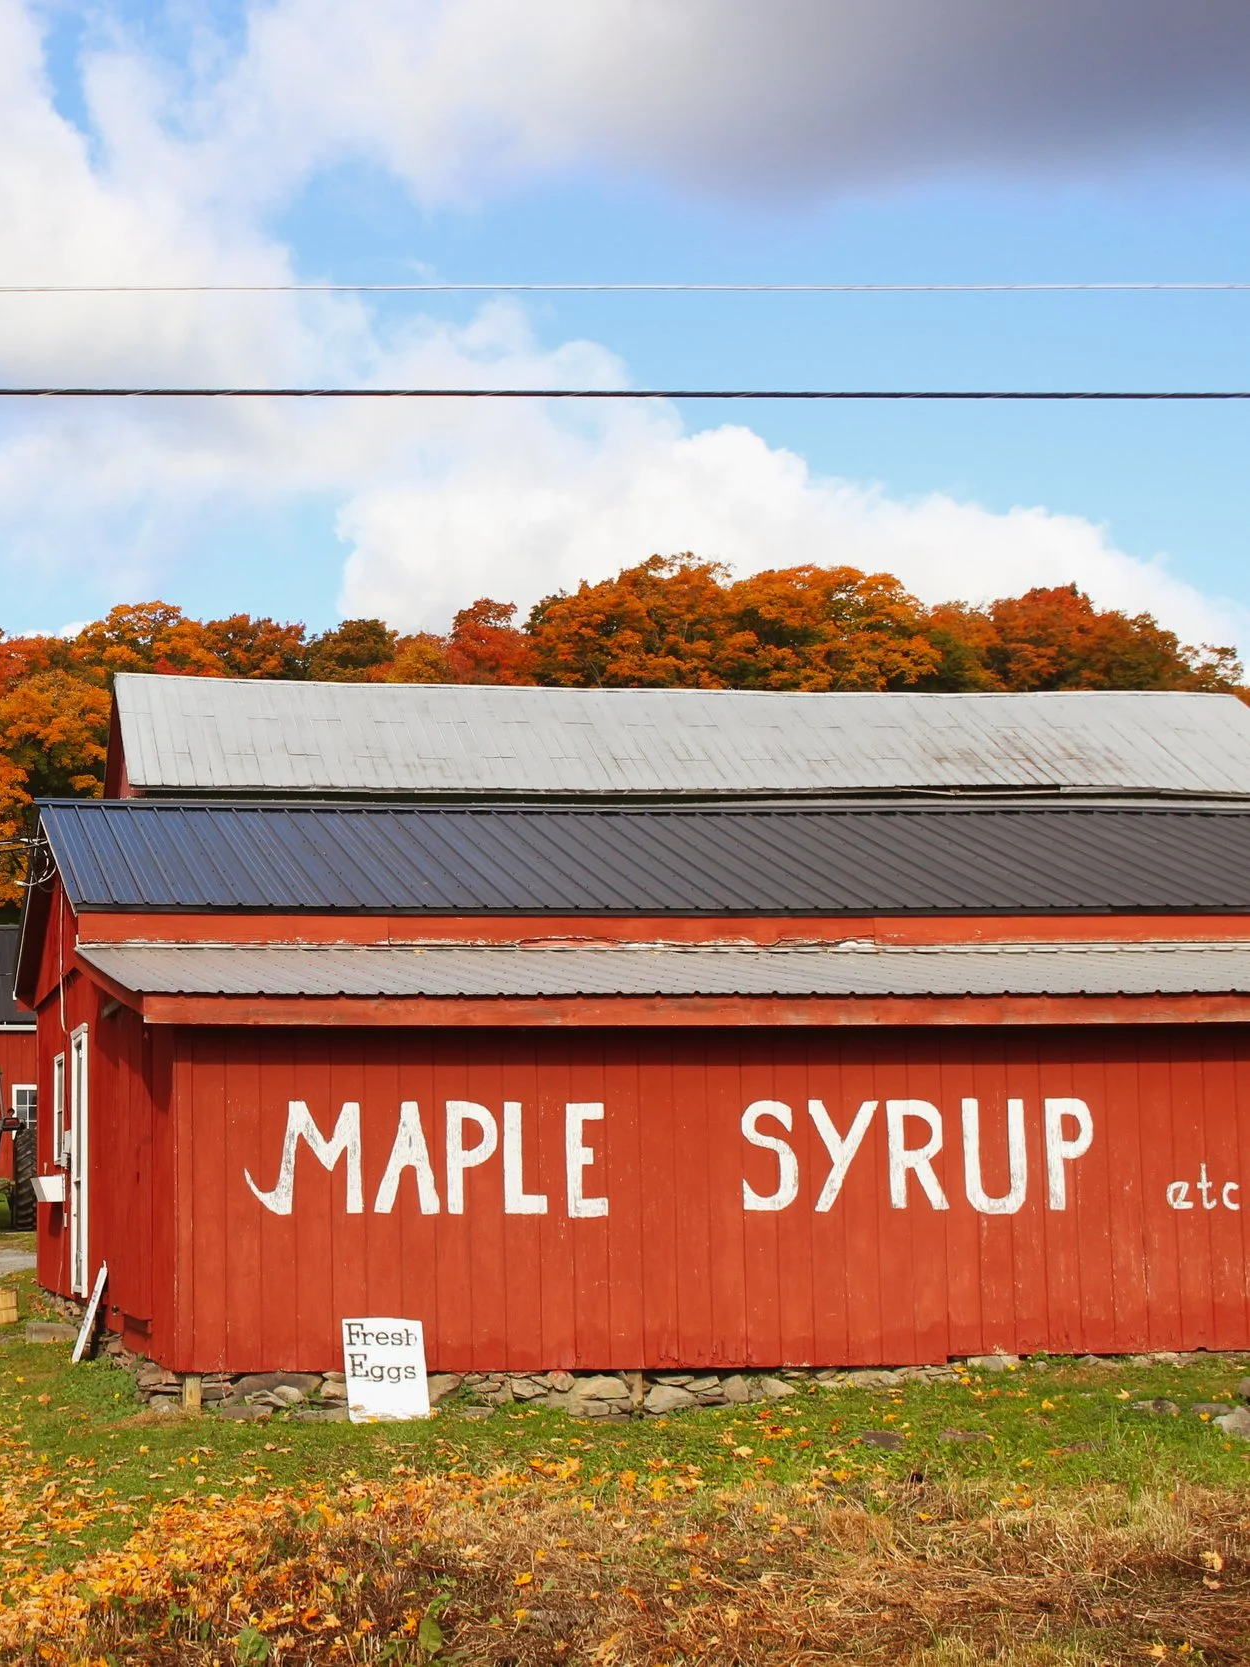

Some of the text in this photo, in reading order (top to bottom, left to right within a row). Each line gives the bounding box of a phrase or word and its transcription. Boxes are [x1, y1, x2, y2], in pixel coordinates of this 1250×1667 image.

[244, 1097, 1240, 1219] MAPLE SYRUP etc
[344, 1322, 418, 1346] Fresh
[348, 1353, 417, 1384] Eggs
